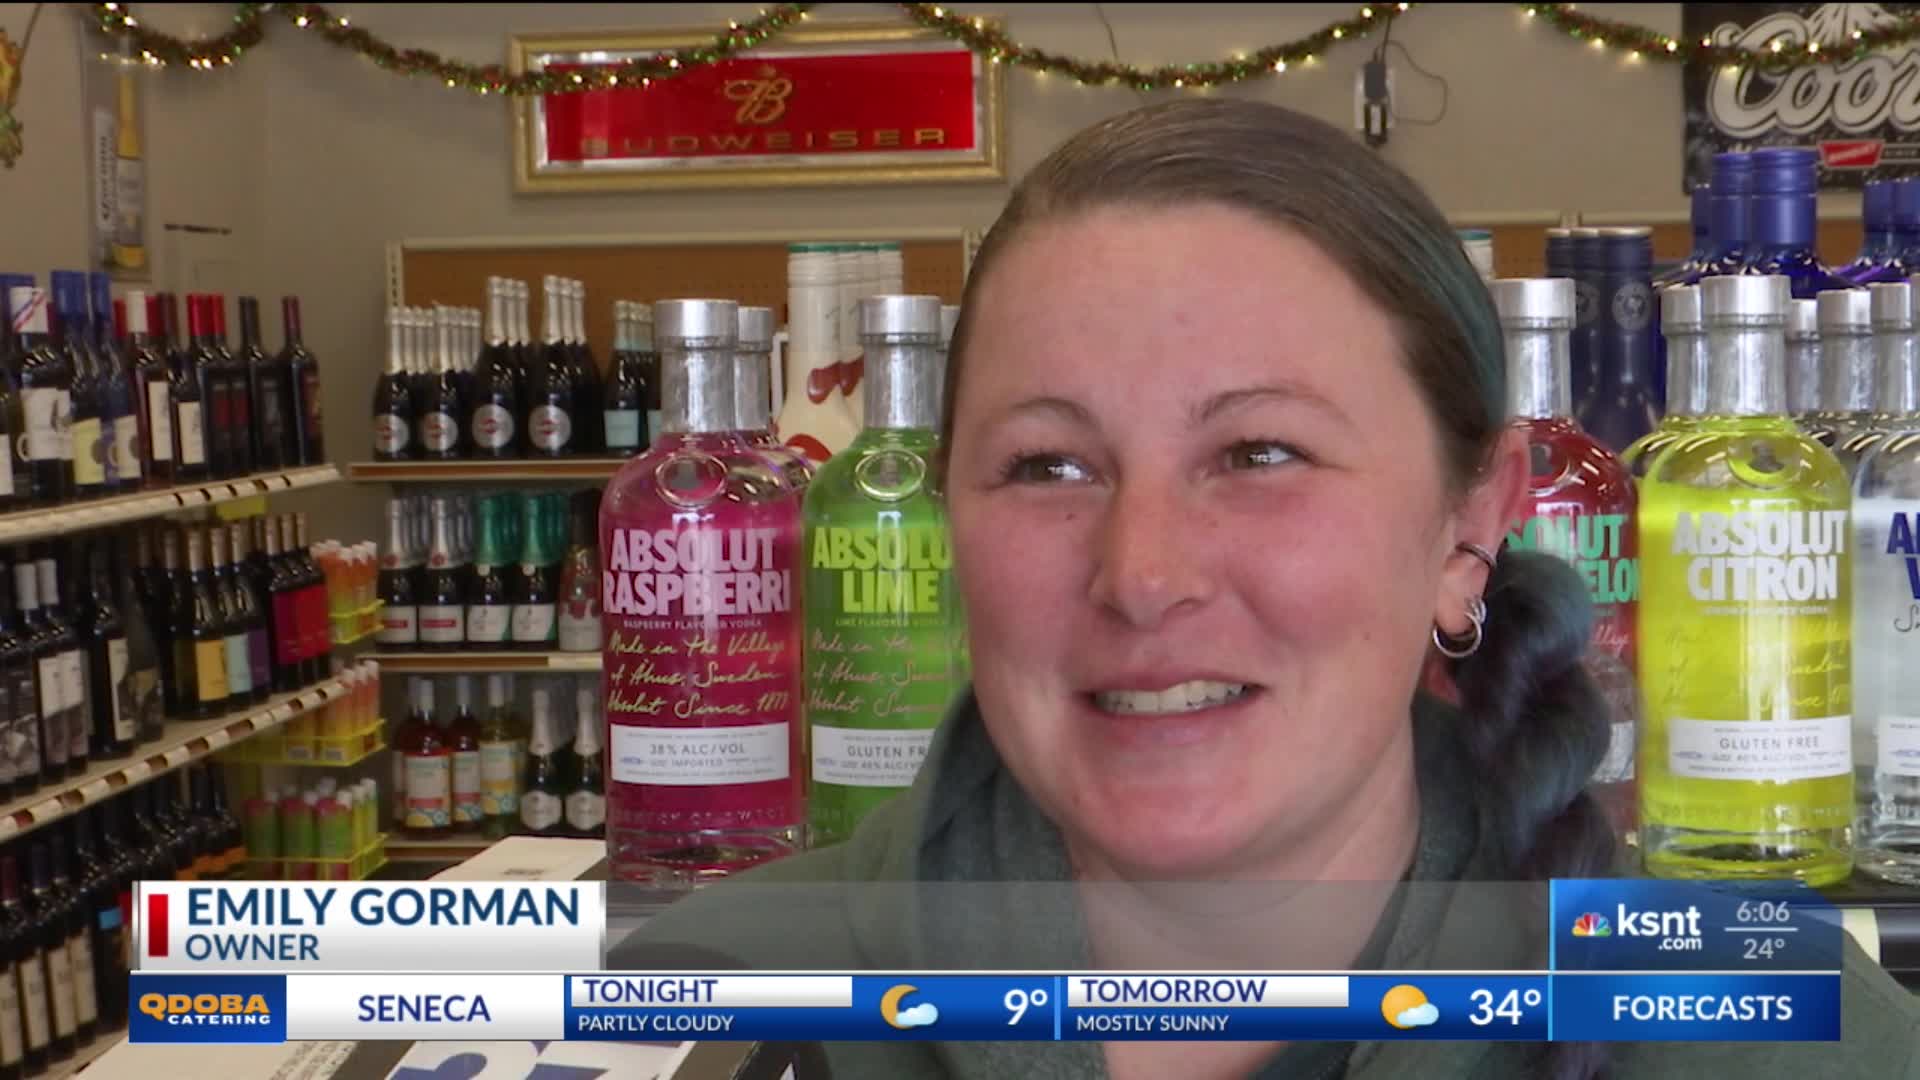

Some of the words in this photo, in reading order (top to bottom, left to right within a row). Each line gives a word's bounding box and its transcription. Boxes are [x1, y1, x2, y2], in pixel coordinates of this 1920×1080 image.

[580, 128, 945, 157] BUDWEISER
[611, 527, 779, 572] ABSOLUT
[812, 527, 953, 570] ABSOLU
[1671, 510, 1849, 556] ABSOLUT
[602, 569, 792, 616] RASPBERRI
[842, 570, 940, 613] LIME
[1687, 555, 1838, 601] CITRON
[607, 630, 645, 656] Made
[651, 641, 677, 655] in
[683, 633, 718, 657] the
[675, 691, 751, 719] Since
[681, 742, 745, 756] ALC/VOL
[847, 745, 902, 758] GLUTEN
[909, 745, 929, 757] FR
[1719, 737, 1781, 750] GLUTEN
[1787, 735, 1820, 749] FREE
